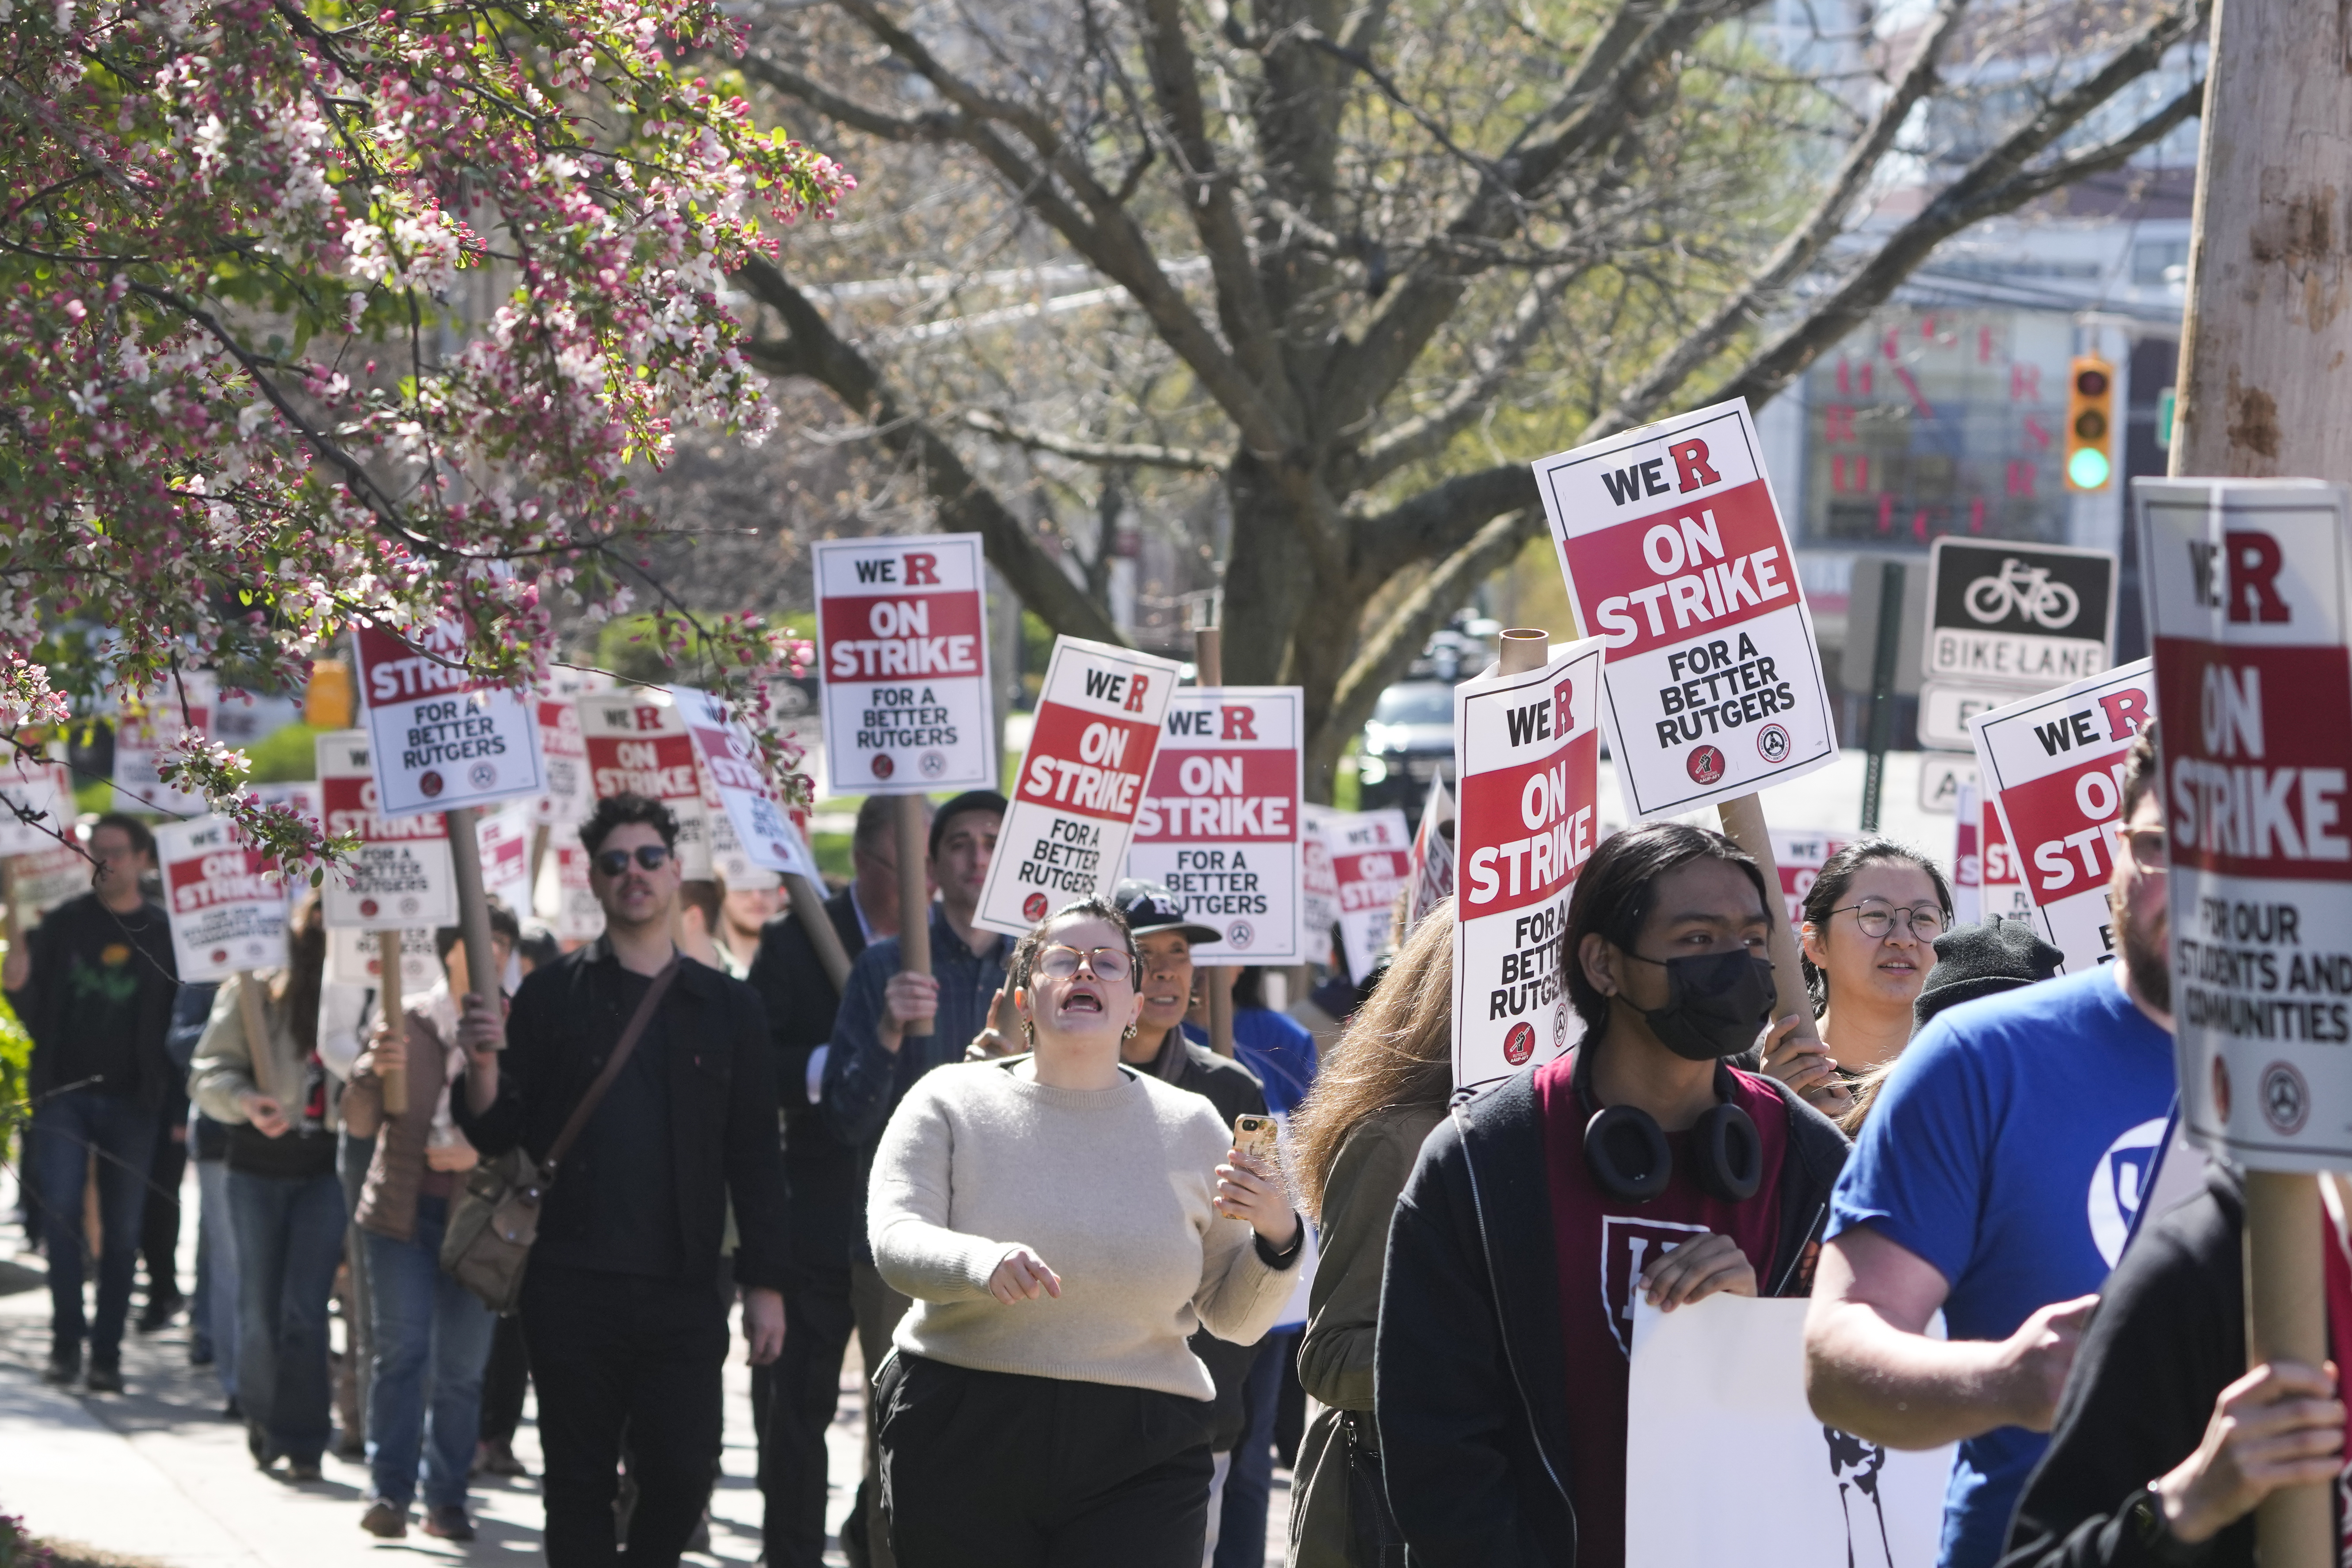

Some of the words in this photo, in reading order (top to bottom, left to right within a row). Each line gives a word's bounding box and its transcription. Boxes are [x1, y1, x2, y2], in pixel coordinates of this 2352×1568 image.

[1601, 457, 1670, 506] WE
[1669, 438, 1721, 494] R
[1643, 509, 1726, 576] ON
[855, 560, 896, 583] WE
[903, 553, 940, 585] R
[2226, 529, 2291, 624] R
[1596, 546, 1789, 649] STRIKE
[870, 599, 928, 637] ON
[831, 635, 977, 677] STRIKE
[1668, 639, 1732, 681] FOR
[1738, 632, 1759, 660] A
[1938, 637, 2009, 672] BIKE
[2018, 643, 2098, 676] LANE
[872, 689, 913, 707] FOR
[922, 687, 935, 704] A
[1086, 669, 1126, 702] WE
[1124, 674, 1148, 713] R
[1660, 656, 1780, 717] BETTER
[415, 702, 456, 725] FOR
[465, 698, 479, 716] A
[635, 706, 663, 730] R
[863, 708, 947, 727] BETTER
[1168, 712, 1212, 735] WE
[1221, 706, 1257, 740] R
[1507, 698, 1550, 748] WE
[1554, 679, 1574, 741] R
[1656, 683, 1795, 748] RUTGERS
[2034, 710, 2100, 756] WE
[2098, 688, 2148, 742] R
[2202, 664, 2264, 759] ON
[408, 717, 493, 747] BETTER
[857, 727, 958, 748] RUTGERS
[1080, 722, 1130, 768] ON
[403, 736, 506, 770] RUTGERS
[617, 741, 657, 768] ON
[596, 765, 698, 798] STRIKE
[1024, 755, 1141, 814] STRIKE
[1180, 756, 1243, 795] ON
[1699, 774, 1720, 783] AAUP-AFT
[1522, 760, 1565, 831] ON
[2173, 756, 2348, 860] STRIKE
[328, 811, 443, 840] STRIKE
[1050, 819, 1089, 844] FOR
[1089, 828, 1100, 847] A
[1135, 797, 1290, 836] STRIKE
[202, 854, 246, 877] ON
[1034, 840, 1100, 870] BETTER
[1177, 851, 1223, 870] FOR
[1233, 851, 1246, 870] A
[1468, 805, 1591, 904] STRIKE
[1791, 841, 1819, 858] WE
[1018, 861, 1097, 894] RUTGERS
[1166, 874, 1257, 892] BETTER
[1180, 896, 1268, 914] UTGERS
[1516, 907, 1554, 949] FOR
[1557, 900, 1566, 931] A
[2236, 900, 2299, 944] OUR
[1502, 932, 1563, 985] BETTE
[2179, 939, 2278, 991] STUDENTS
[2287, 956, 2352, 997] AND
[1489, 967, 1561, 1021] RUTGE
[2185, 988, 2350, 1044] COMMUNITIES
